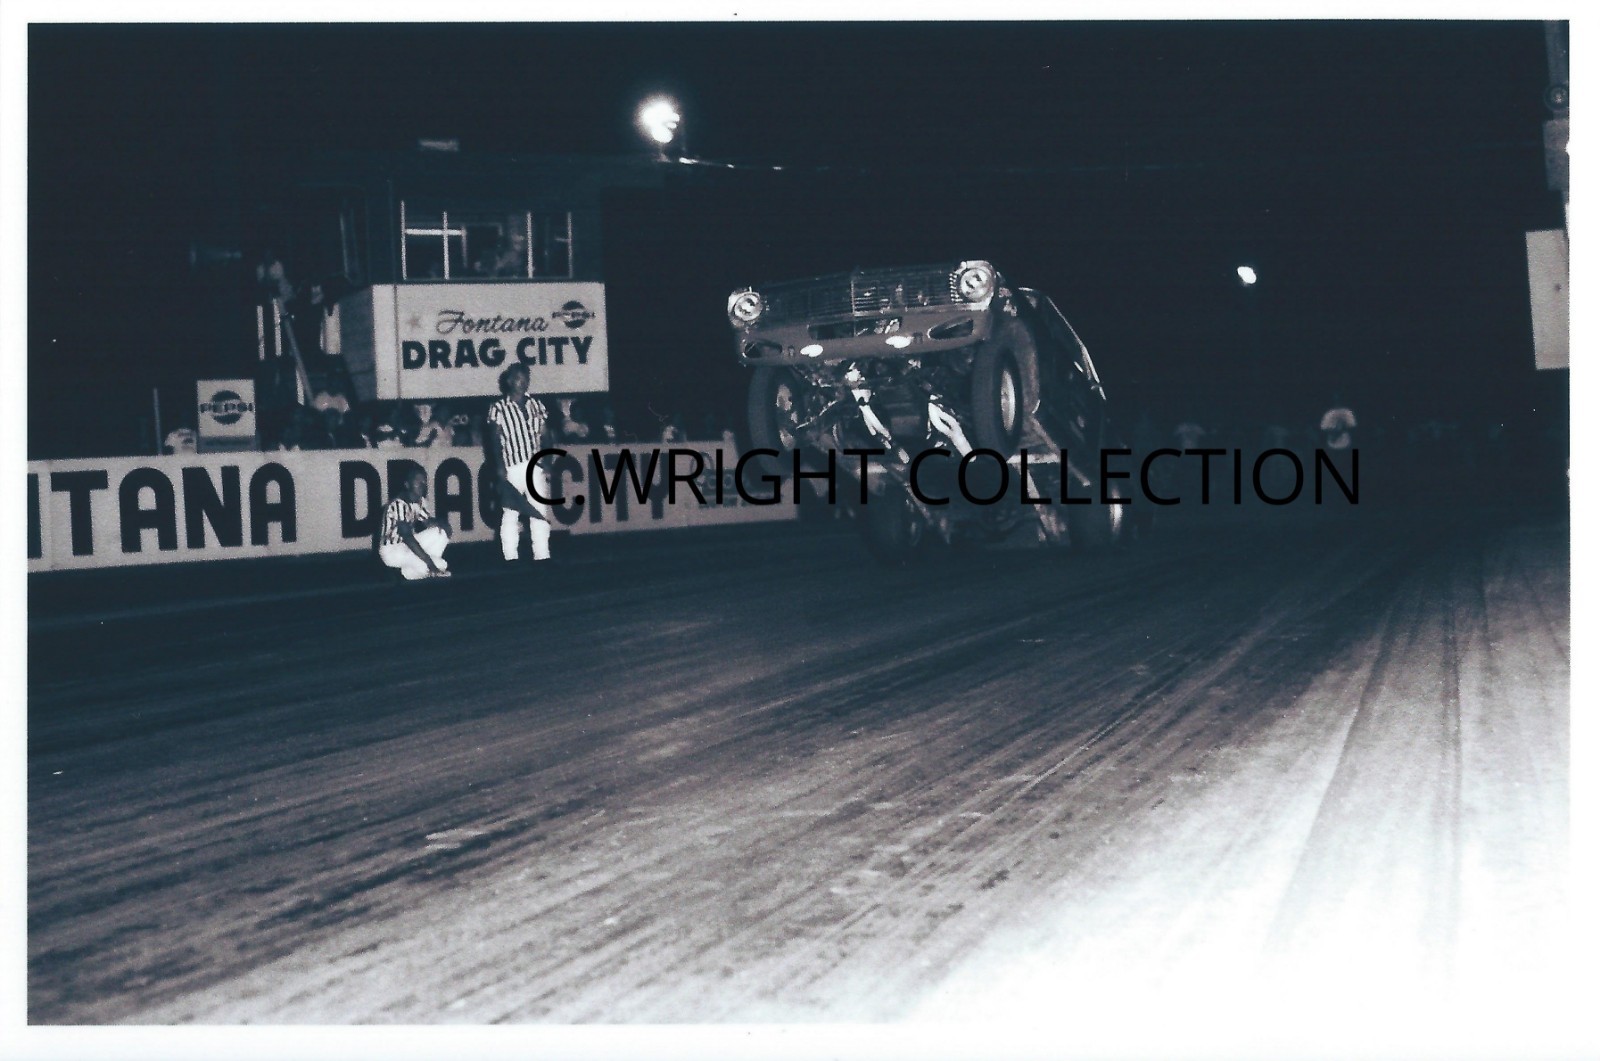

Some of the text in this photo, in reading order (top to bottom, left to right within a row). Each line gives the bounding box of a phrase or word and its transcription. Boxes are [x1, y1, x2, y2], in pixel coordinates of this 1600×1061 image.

[436, 310, 549, 335] Fontana
[402, 336, 593, 370] DRAG CITY
